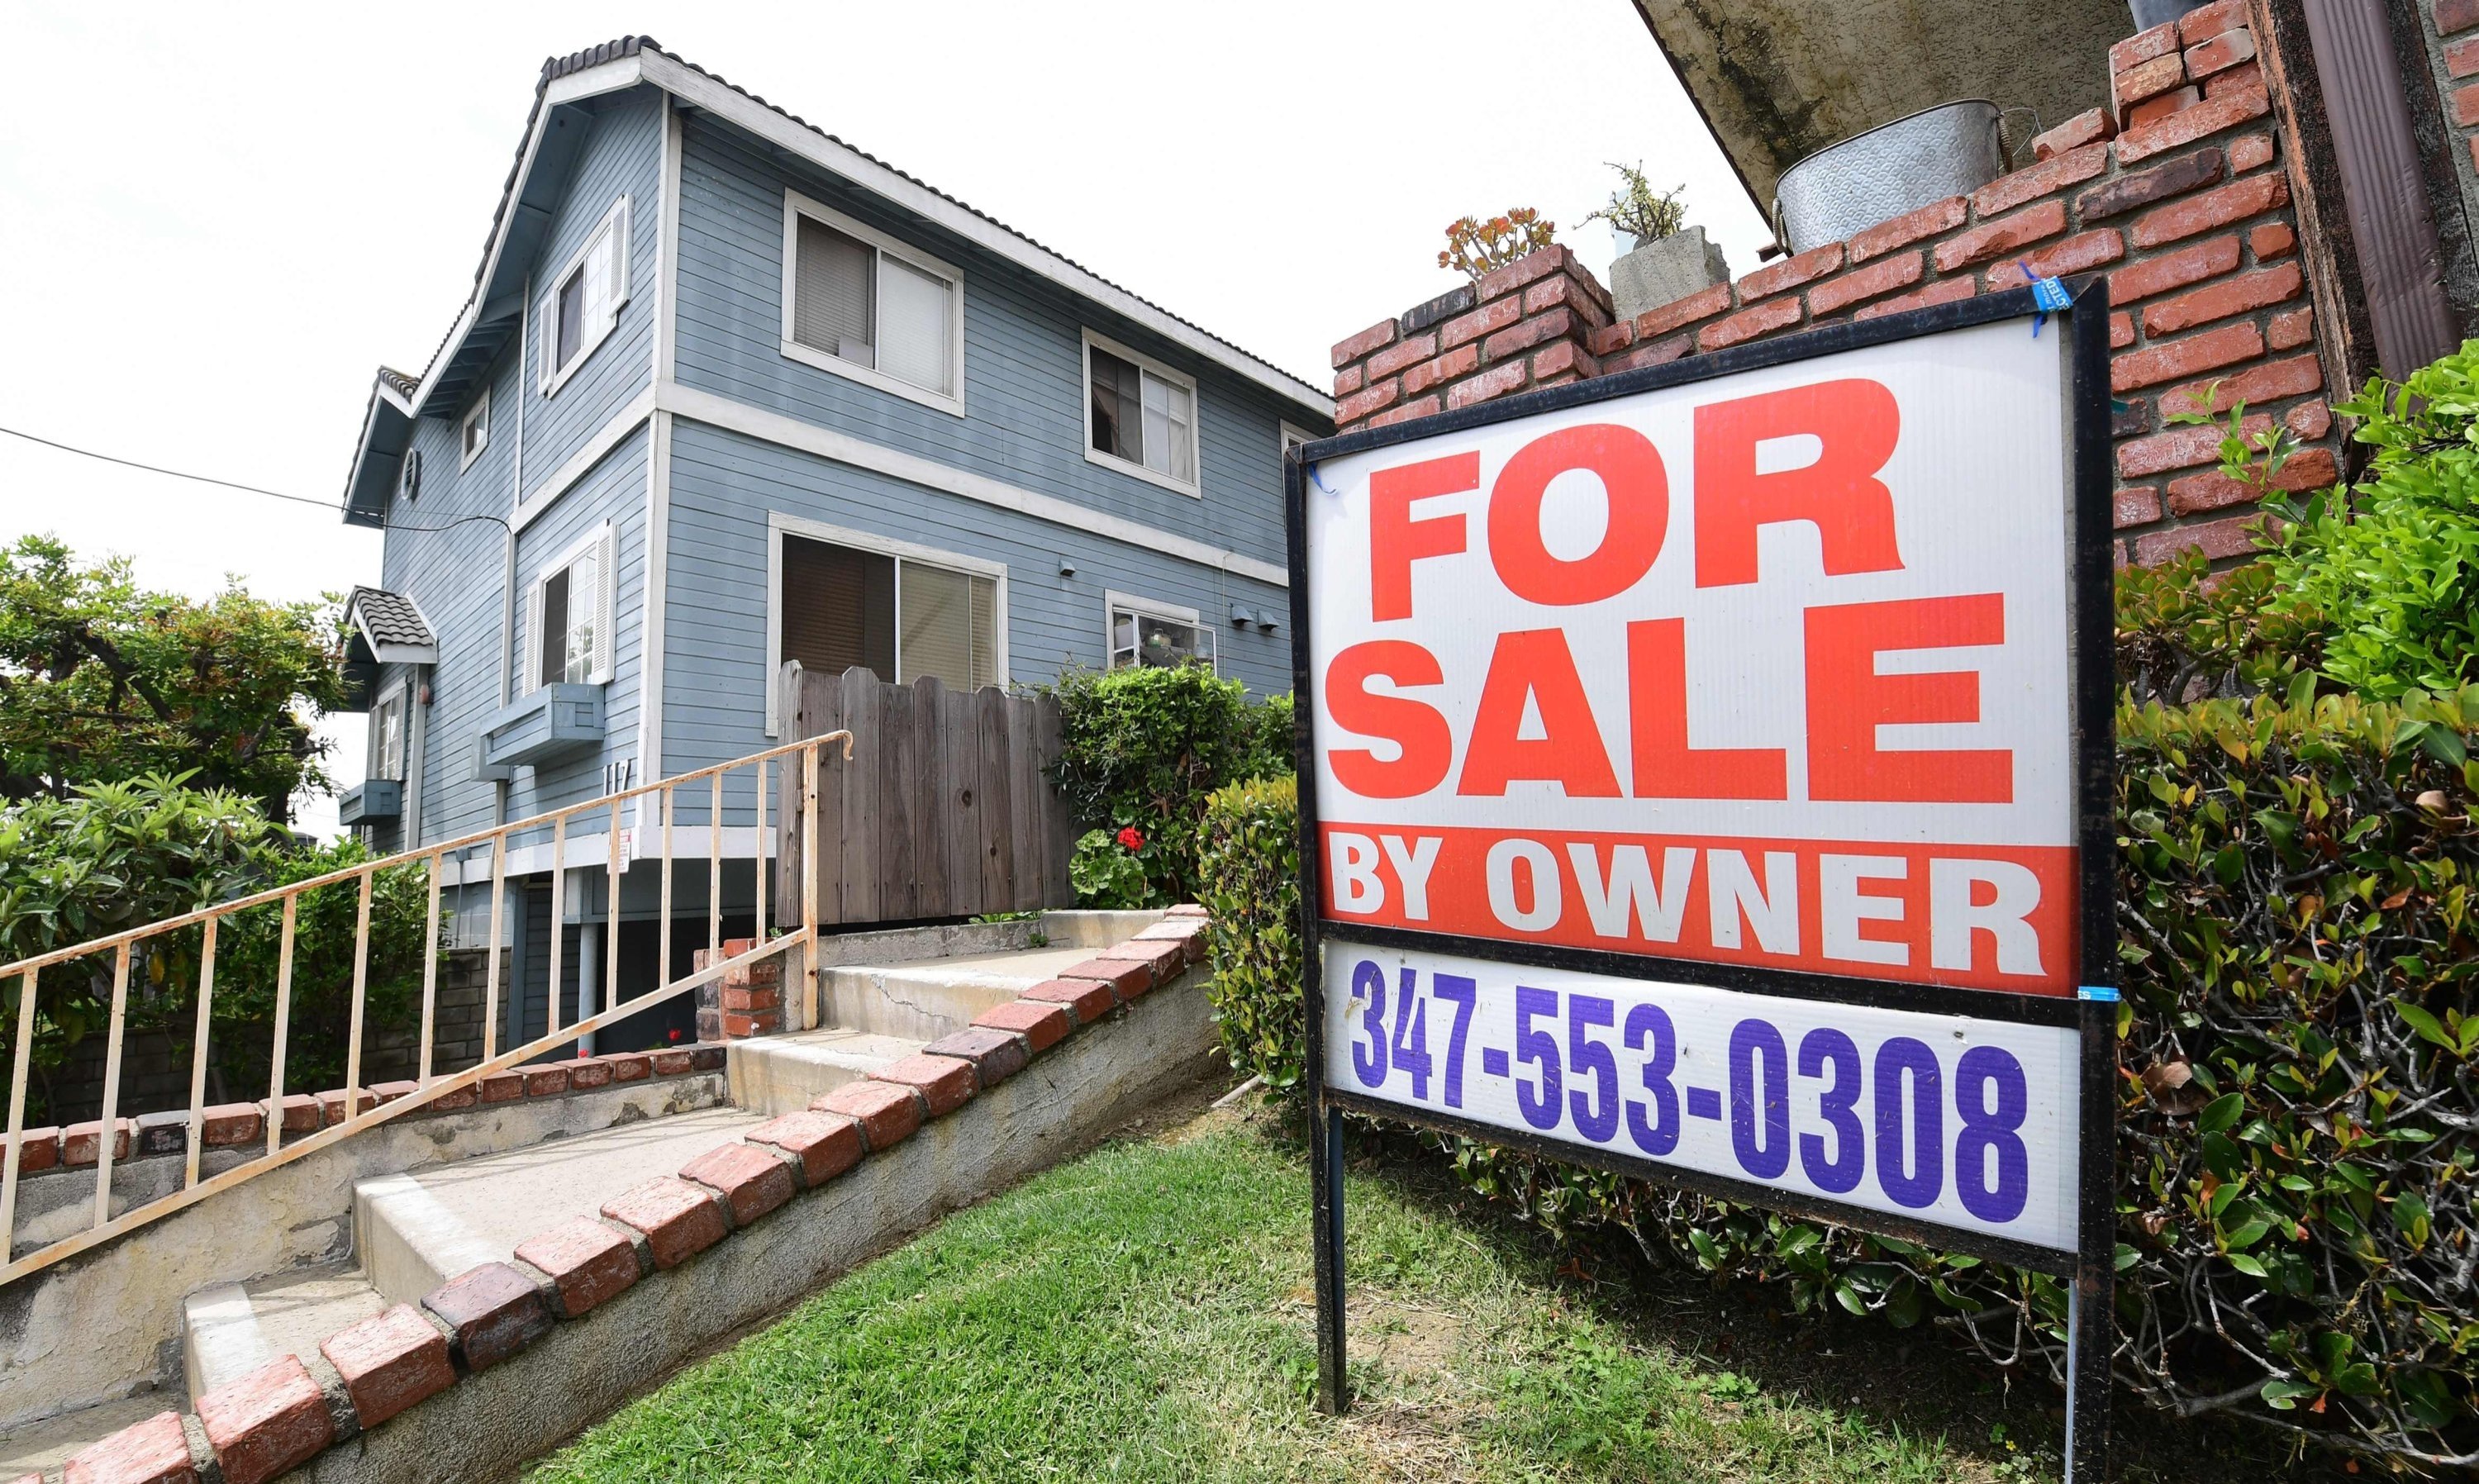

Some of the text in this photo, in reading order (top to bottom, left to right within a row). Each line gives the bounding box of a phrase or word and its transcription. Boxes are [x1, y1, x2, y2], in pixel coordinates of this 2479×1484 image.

[1371, 378, 1905, 622] FOR
[602, 759, 630, 797] 117
[1325, 592, 2013, 804] SALE
[1328, 831, 2047, 976] BY OWNER
[1351, 958, 2029, 1224] 347-553-0308
